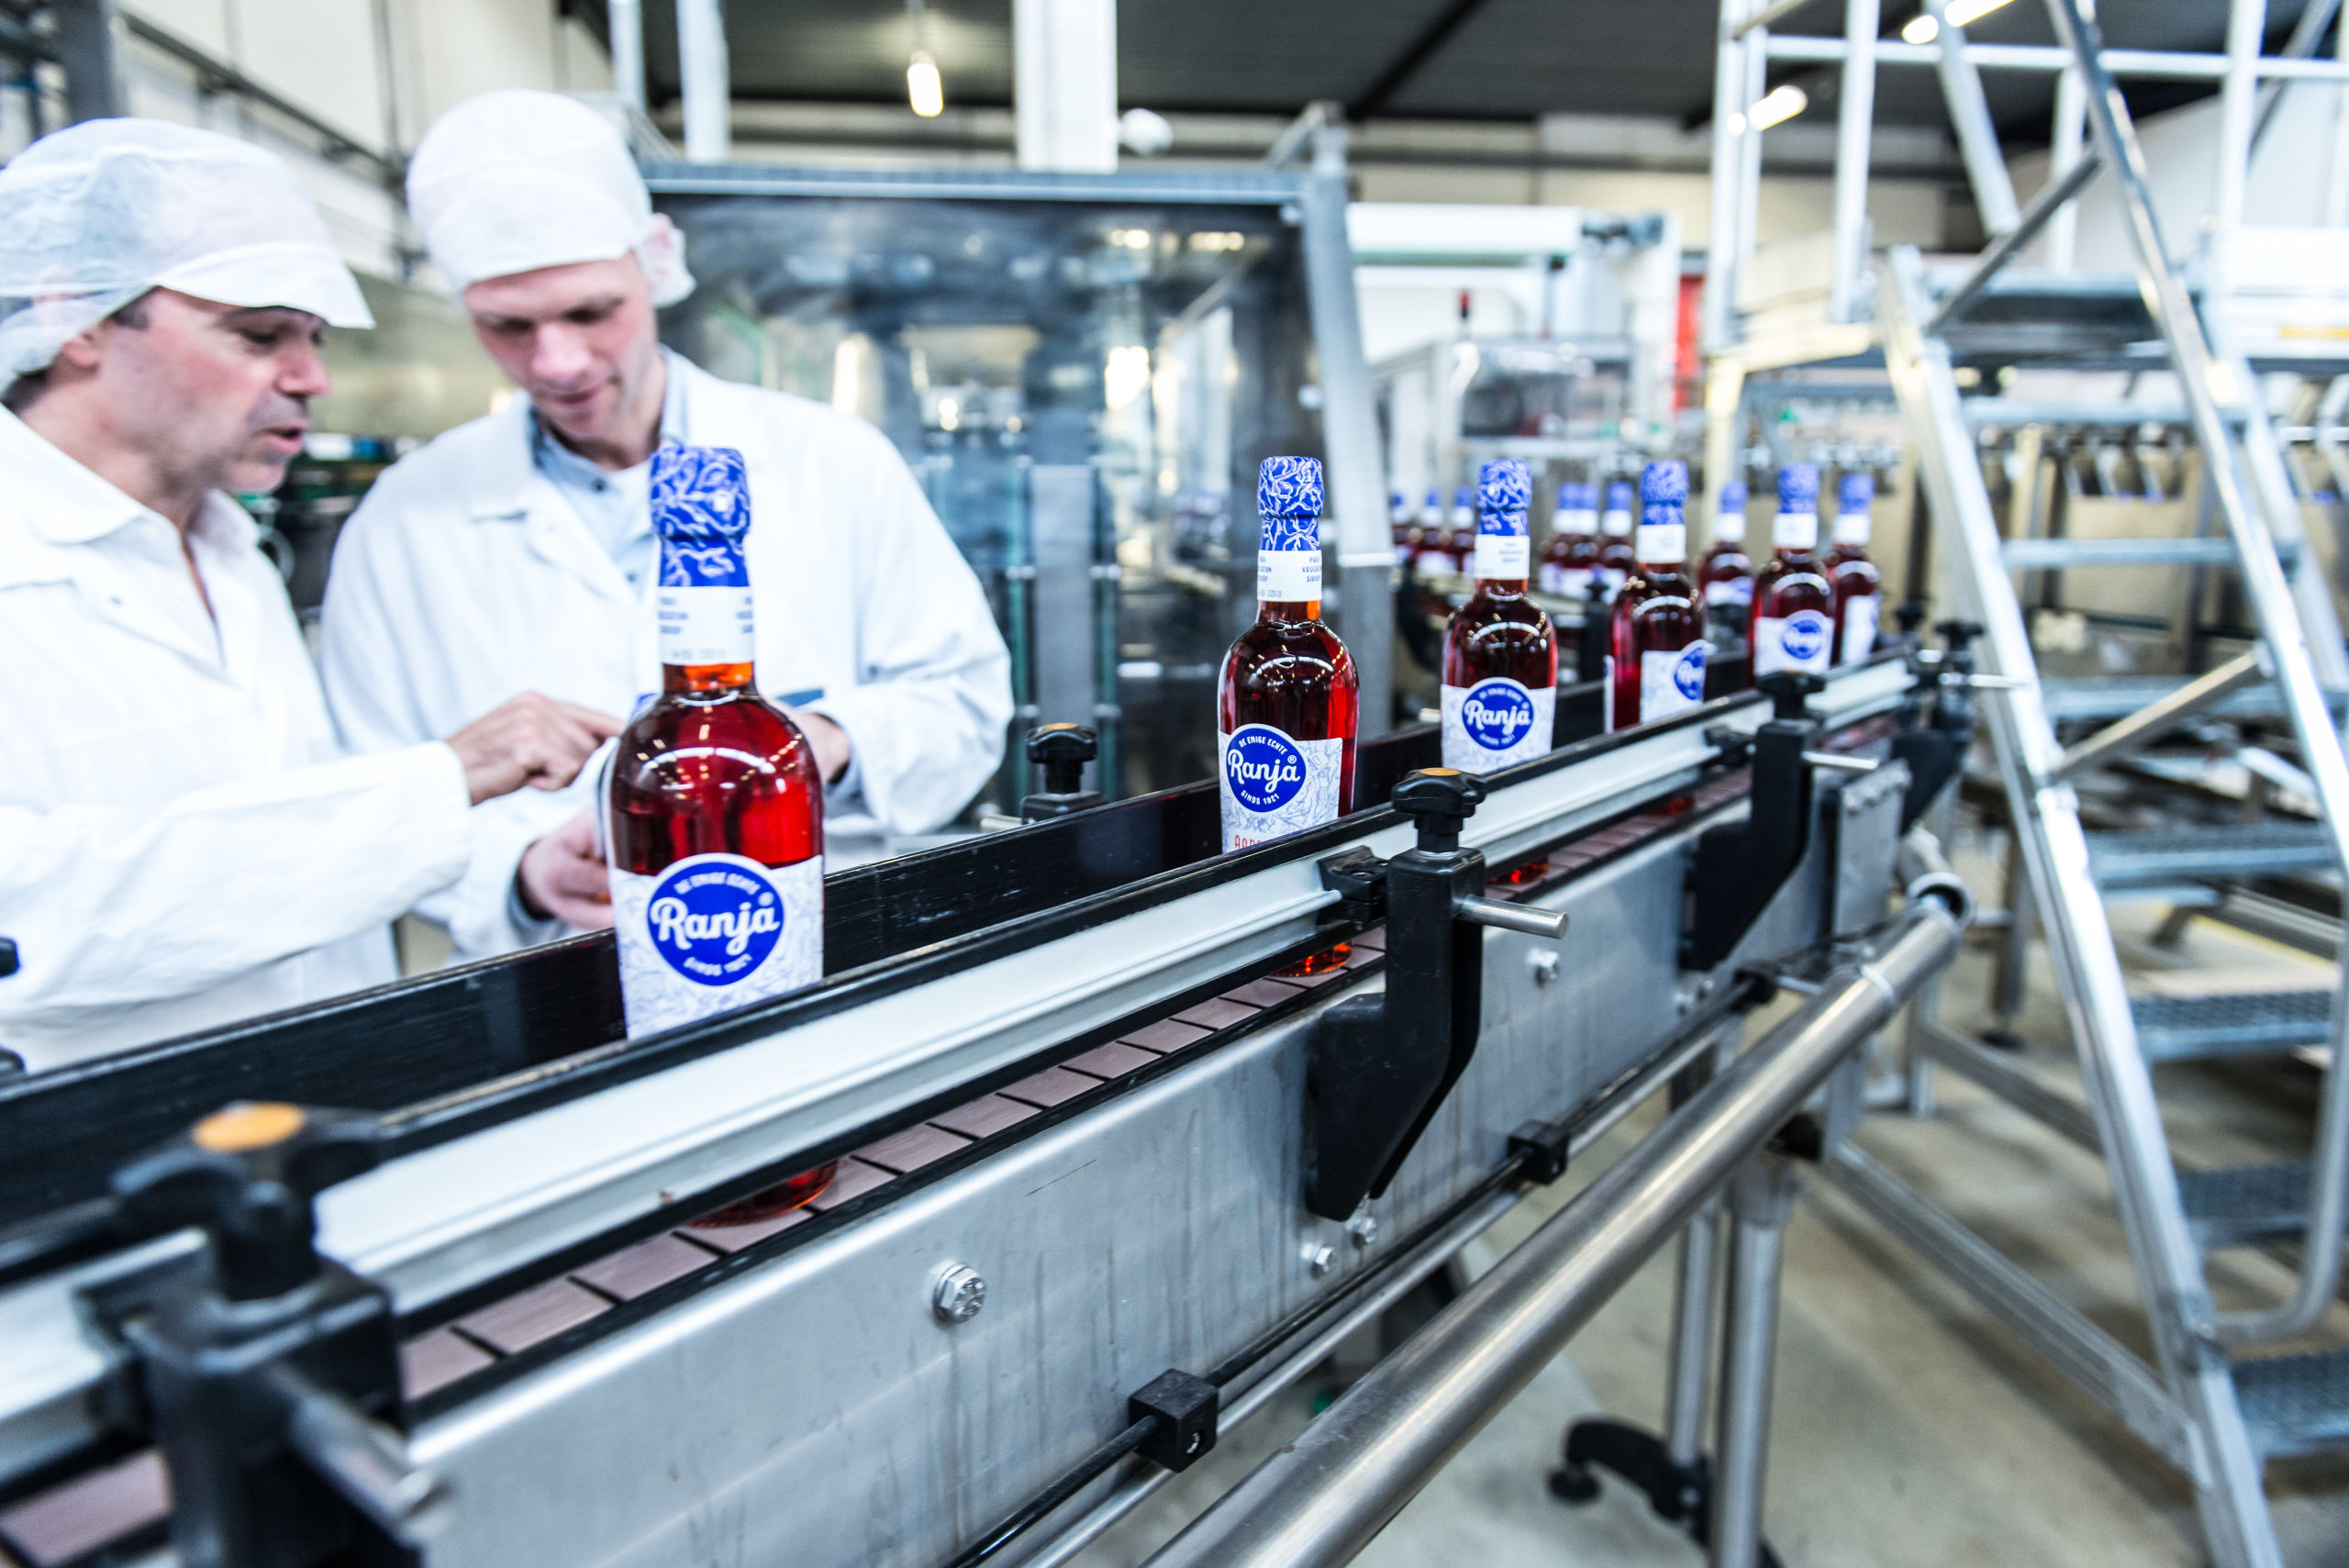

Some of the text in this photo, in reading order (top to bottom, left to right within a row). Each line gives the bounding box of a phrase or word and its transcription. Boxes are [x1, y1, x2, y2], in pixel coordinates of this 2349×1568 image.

[1464, 699, 1531, 736] Ranja
[1238, 736, 1288, 755] DE ENIGE ECHTE
[1228, 749, 1300, 793] Ranja
[650, 896, 780, 956] Ranja
